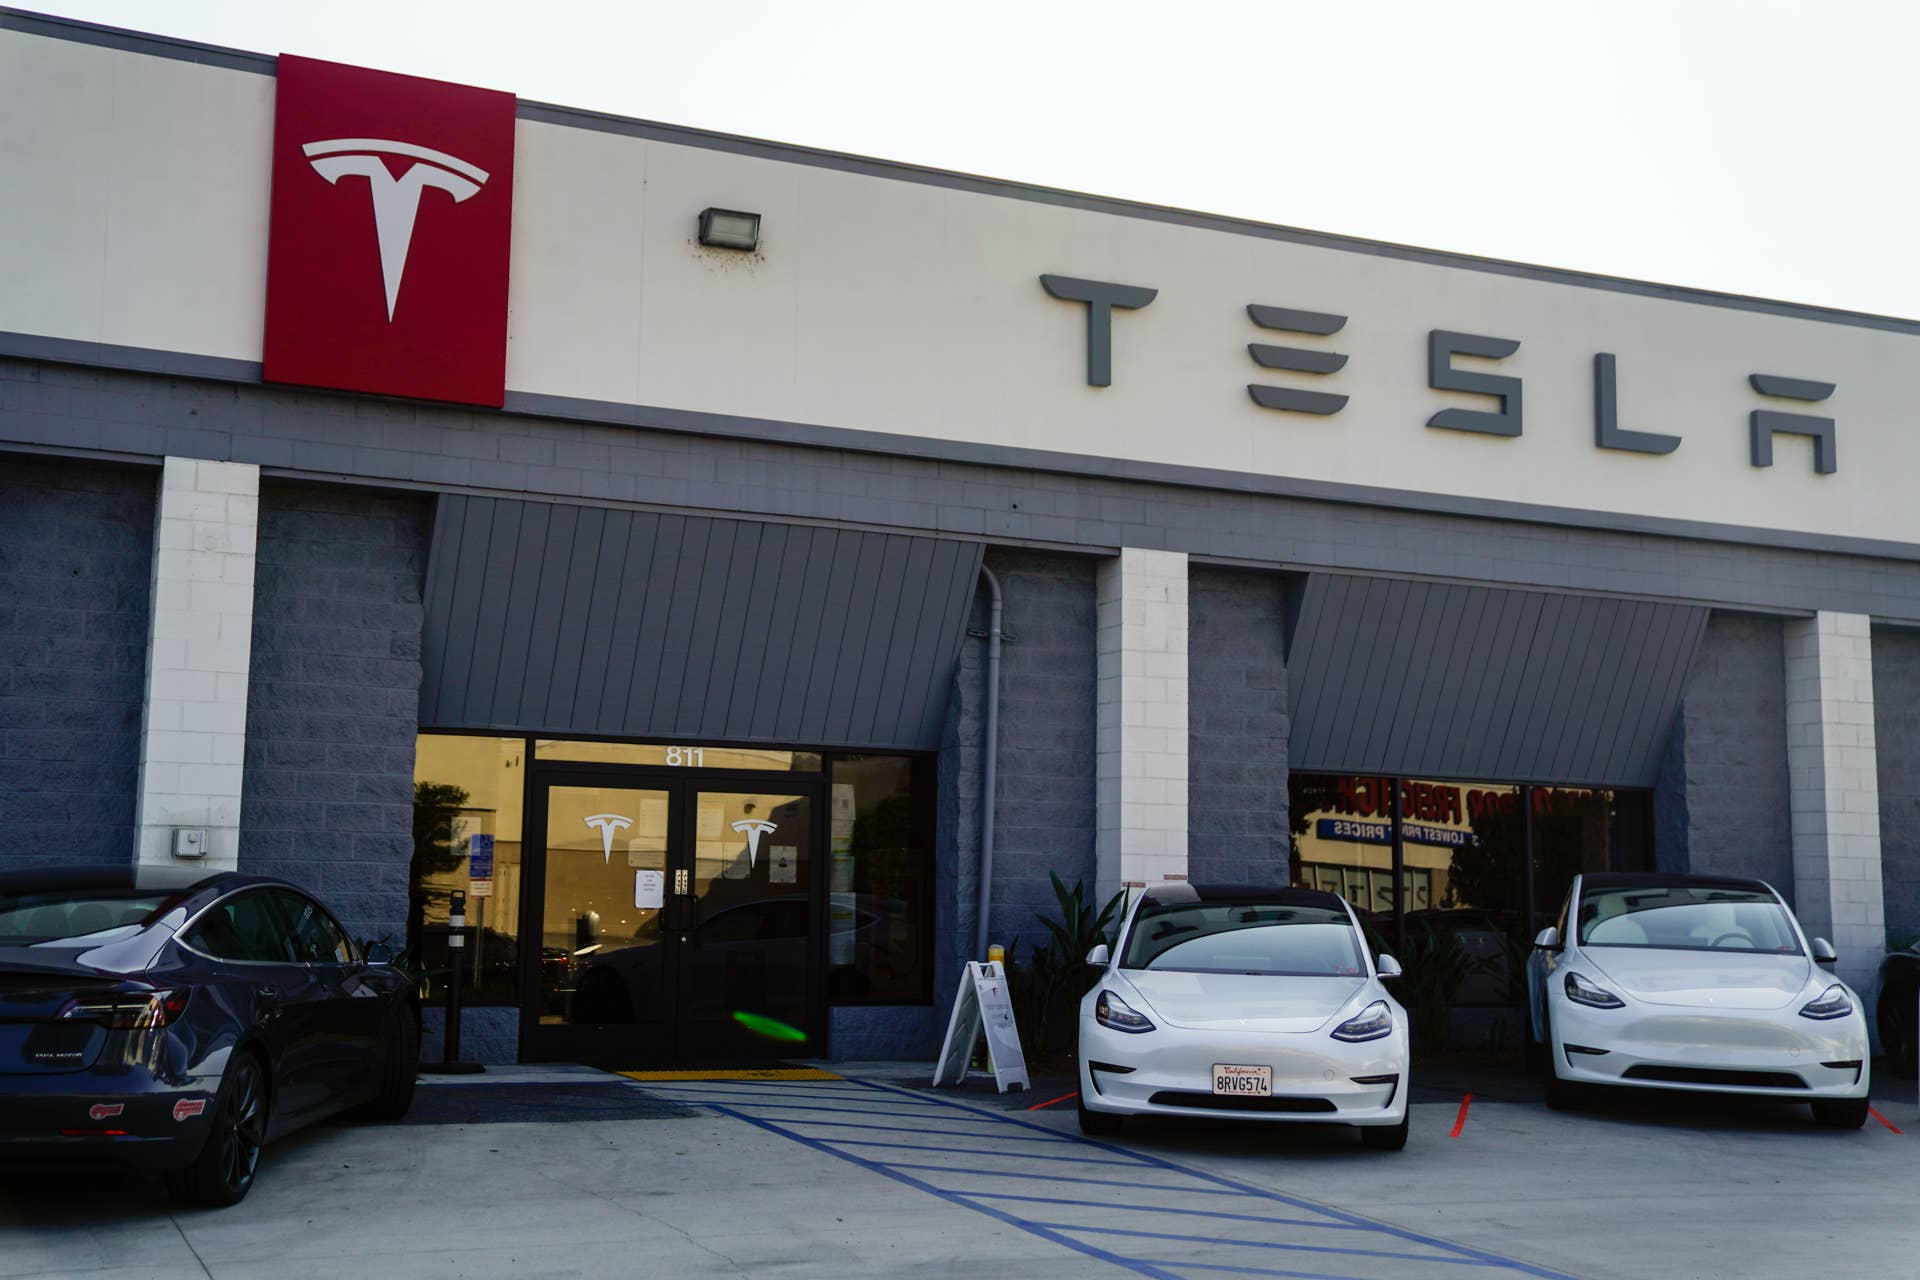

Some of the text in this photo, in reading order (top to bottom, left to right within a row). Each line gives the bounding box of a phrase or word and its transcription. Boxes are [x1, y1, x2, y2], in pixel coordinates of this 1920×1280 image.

[1038, 273, 1837, 475] TESLA
[666, 746, 703, 767] 811
[1225, 1066, 1259, 1075] California
[1217, 1076, 1267, 1091] 8RVG574
